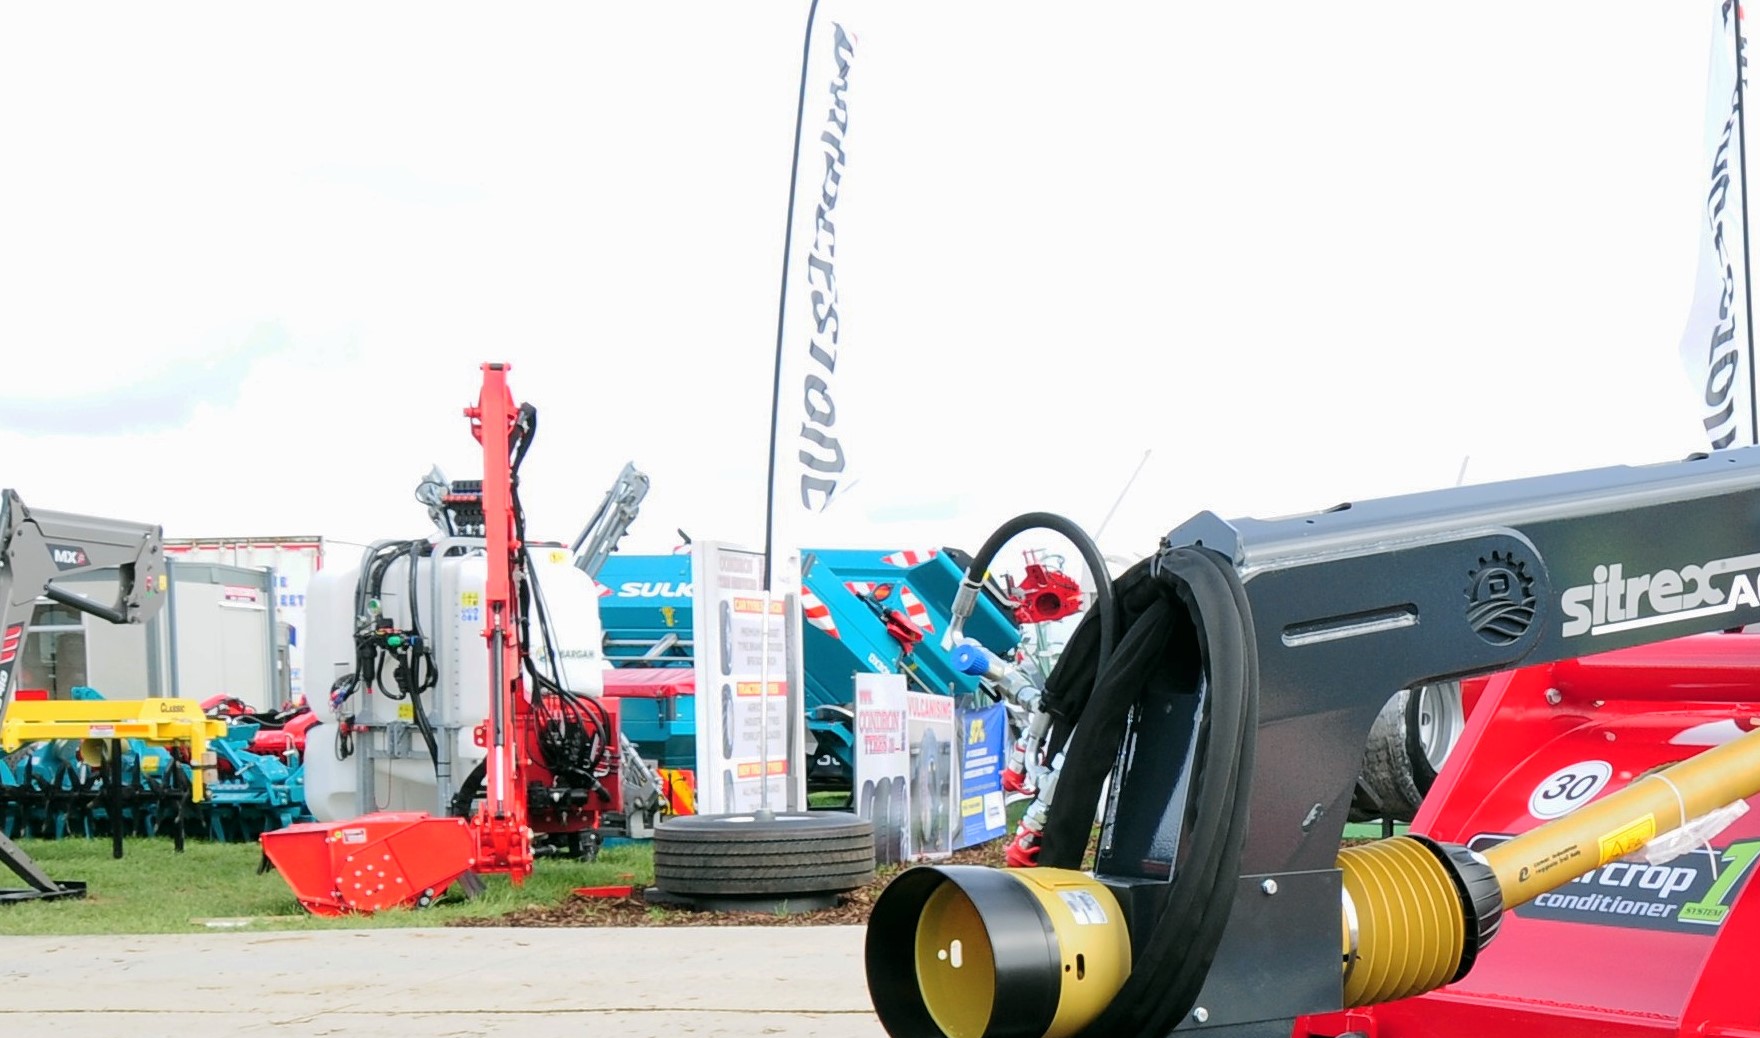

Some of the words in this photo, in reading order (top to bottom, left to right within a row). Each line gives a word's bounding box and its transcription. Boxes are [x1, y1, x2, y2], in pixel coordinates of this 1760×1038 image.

[1561, 561, 1726, 638] sitrex
[859, 711, 900, 732] CONDRON
[1542, 774, 1598, 801] 30
[1572, 862, 1698, 898] rcrop
[1534, 892, 1677, 918] conditioner
[1685, 906, 1723, 918] SYSTEM
